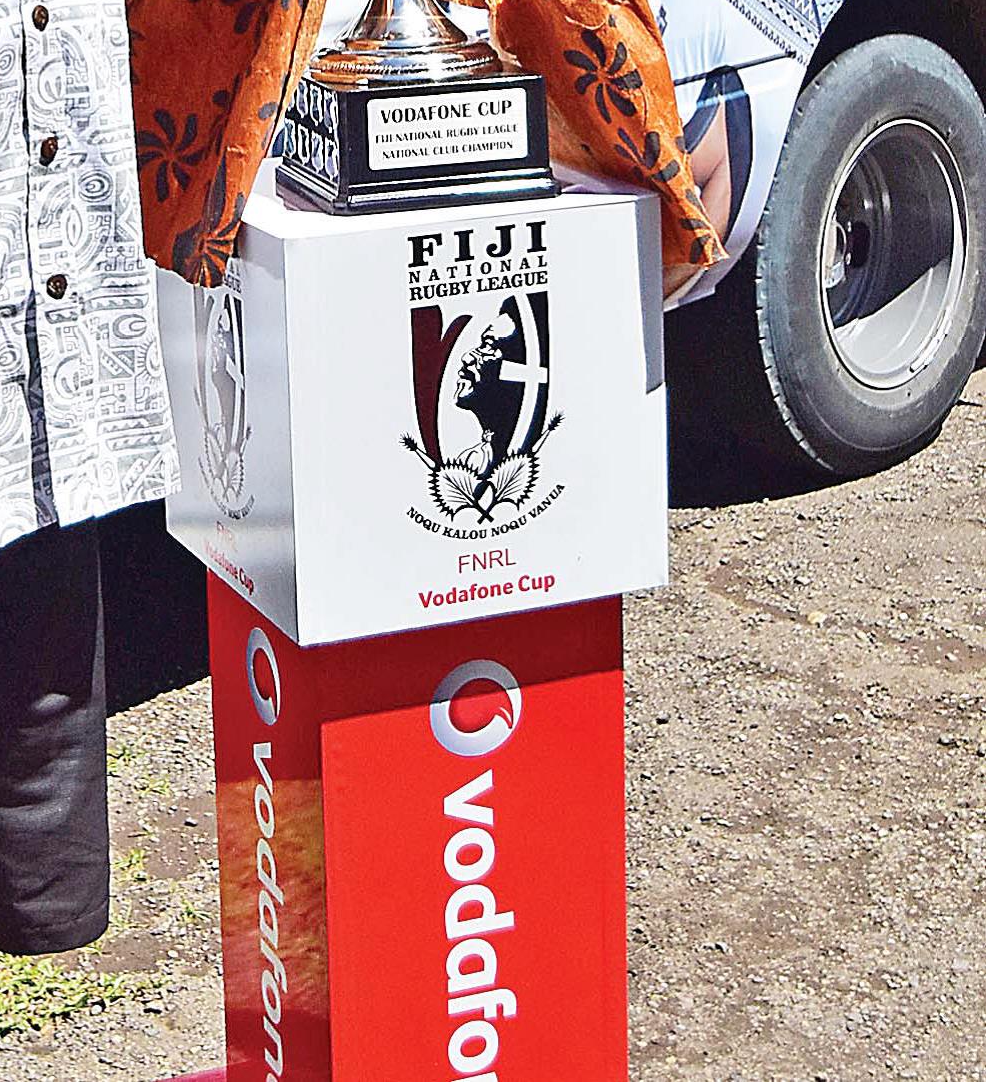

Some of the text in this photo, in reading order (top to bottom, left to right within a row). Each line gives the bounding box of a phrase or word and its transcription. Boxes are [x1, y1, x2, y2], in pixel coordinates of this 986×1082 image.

[380, 99, 512, 124] VODAFONE CUP
[393, 129, 443, 143] NATIONAL
[446, 126, 479, 138] RUGBY
[482, 123, 518, 135] LEAGUE
[382, 140, 514, 159] NATIONAL CLUB CHAMPION
[408, 220, 547, 268] FIJI
[408, 254, 548, 284] NATIONAL
[409, 270, 548, 301] RUGBY LEAGUE
[406, 483, 565, 540] NOQU KALOU NOQU VANUA
[458, 548, 517, 574] FNRL
[418, 574, 556, 609] Vodafone Cup
[253, 742, 288, 1082] vodafon
[443, 769, 517, 1082] vodafo
